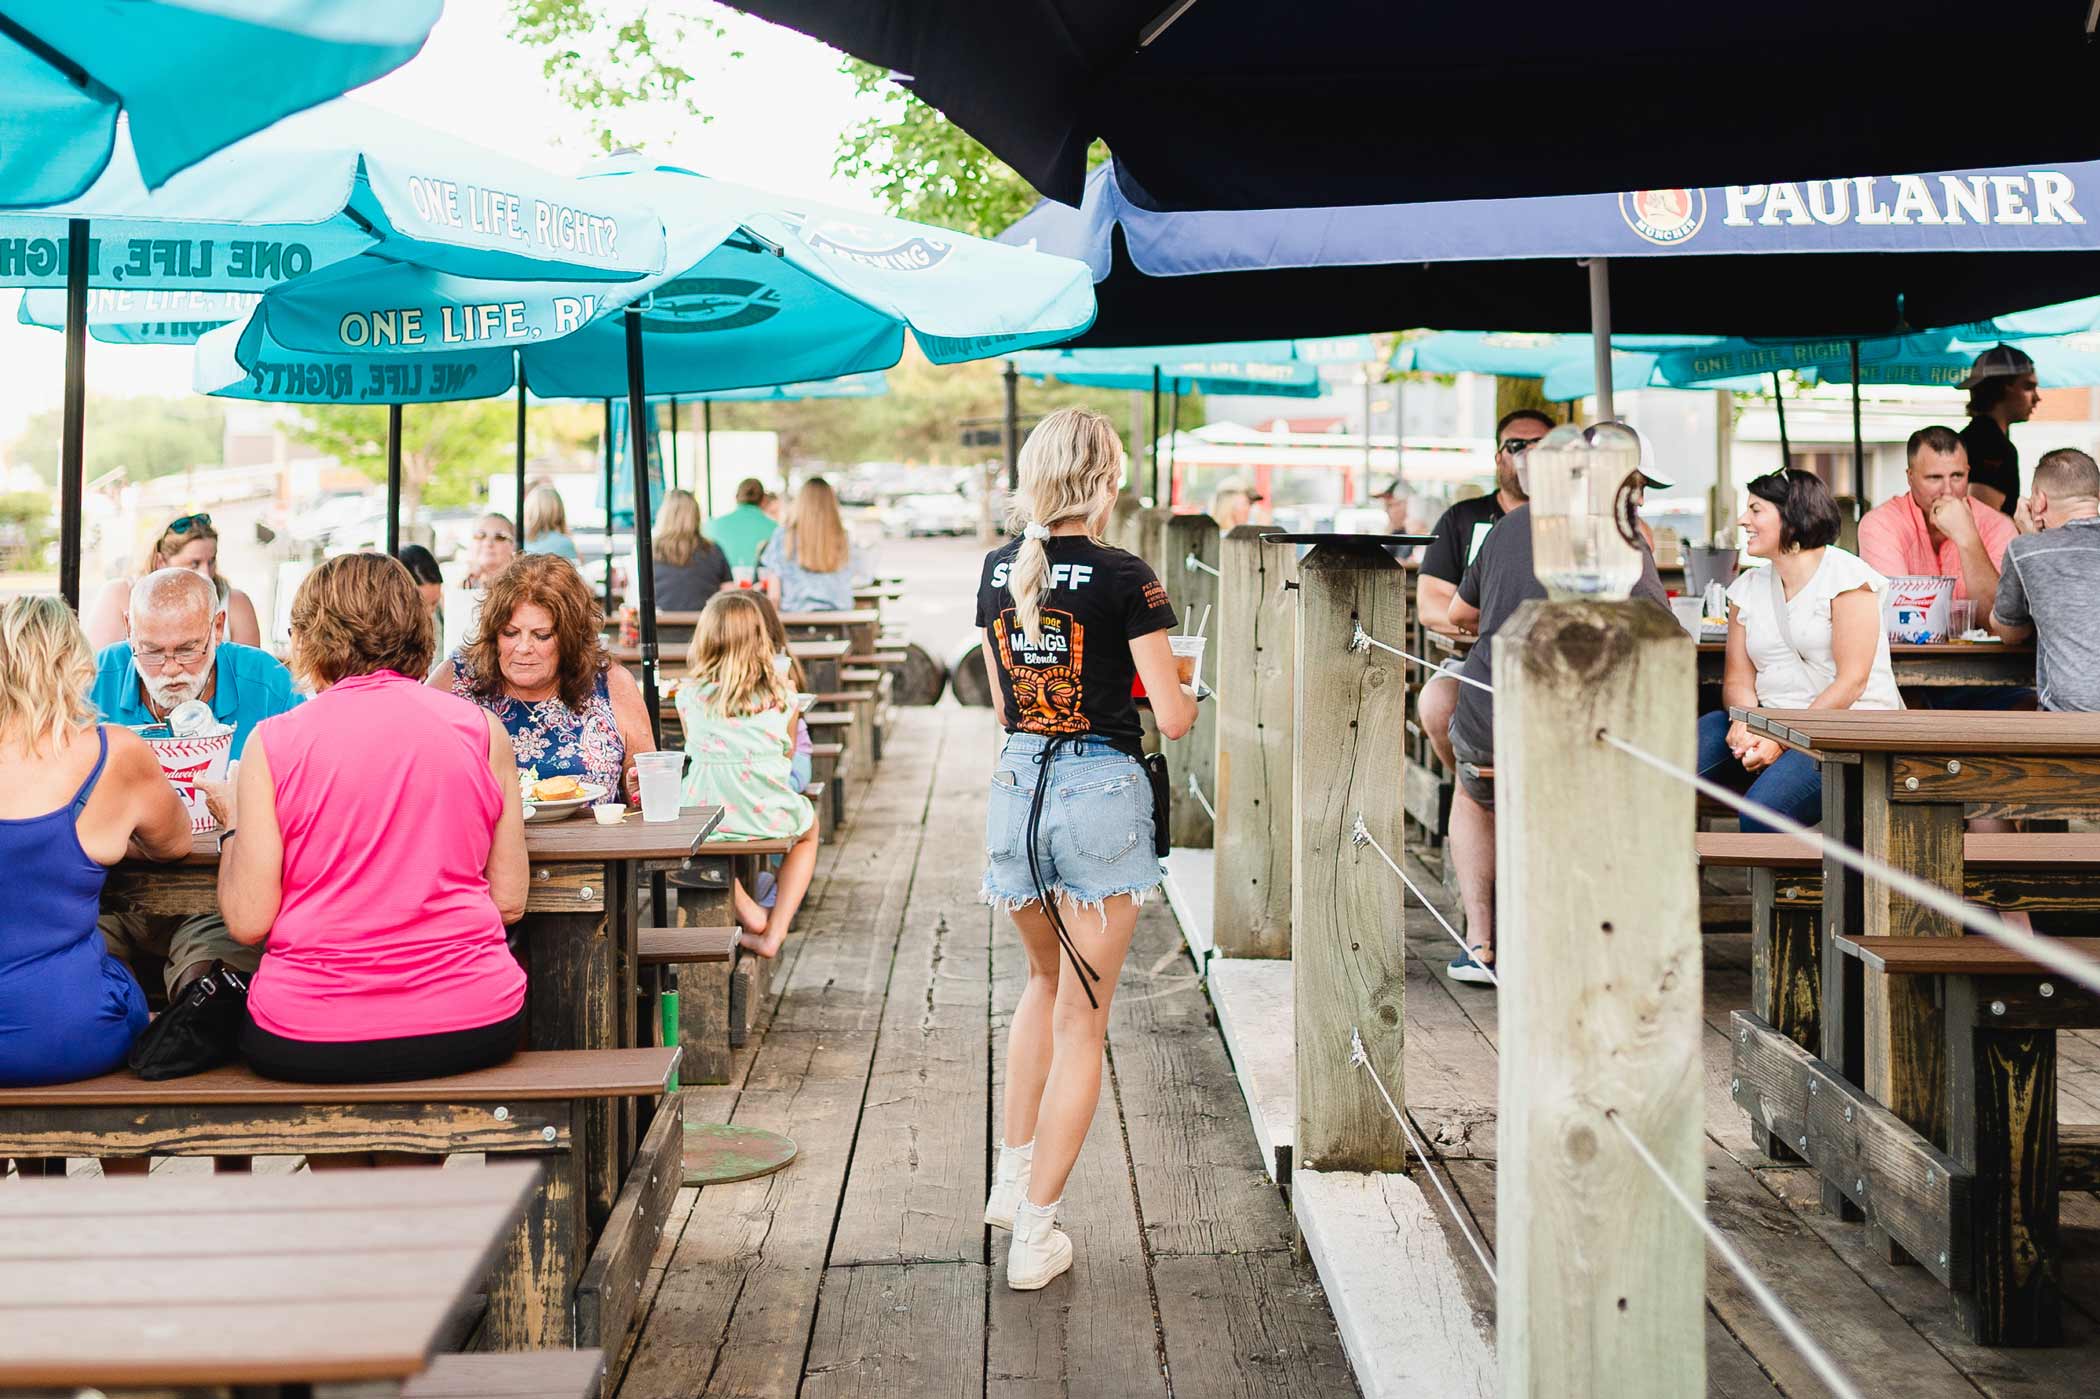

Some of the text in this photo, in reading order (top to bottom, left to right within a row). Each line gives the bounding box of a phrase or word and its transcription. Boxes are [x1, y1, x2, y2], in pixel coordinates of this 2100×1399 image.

[408, 176, 620, 260] ONE LIFE, RIGHT?
[1723, 171, 2086, 225] PAULANER
[339, 308, 426, 347] ONE
[440, 301, 542, 343] LIFE,
[553, 295, 599, 333] RI
[1794, 341, 1861, 361] RIGHT
[990, 562, 1094, 590] SFF
[1023, 652, 1059, 664] Blonde
